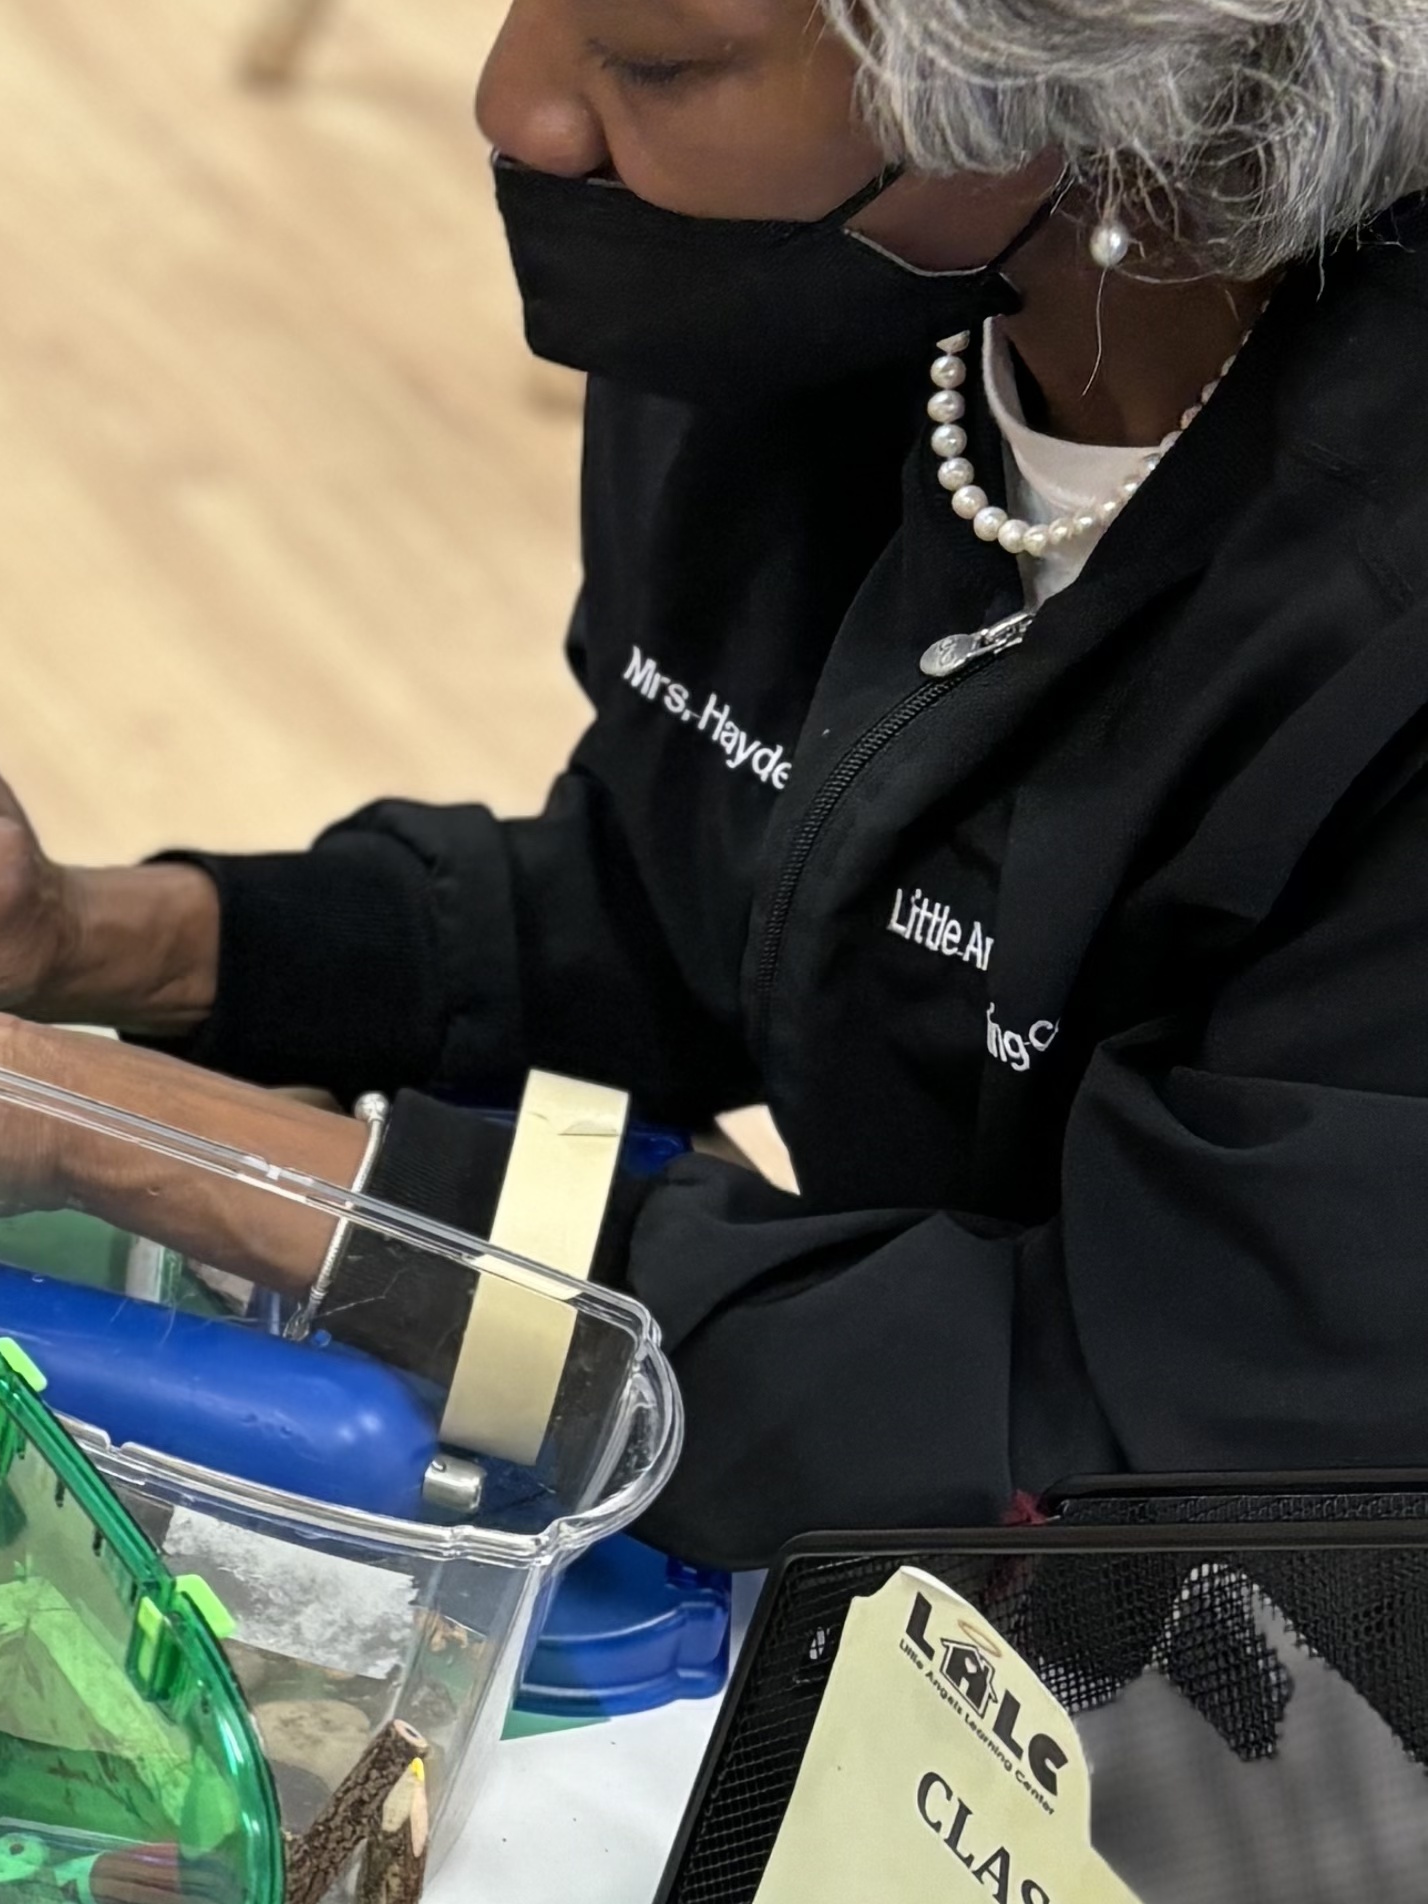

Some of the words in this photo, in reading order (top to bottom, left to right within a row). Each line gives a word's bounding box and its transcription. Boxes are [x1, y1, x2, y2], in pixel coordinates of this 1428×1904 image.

[623, 645, 691, 721] Mrs.
[886, 888, 962, 956] Little
[899, 1638, 924, 1670] Little
[925, 1671, 964, 1716] Angels
[964, 1712, 1013, 1773] Learning
[1015, 1768, 1055, 1816] Center
[906, 1591, 1069, 1796] LALC
